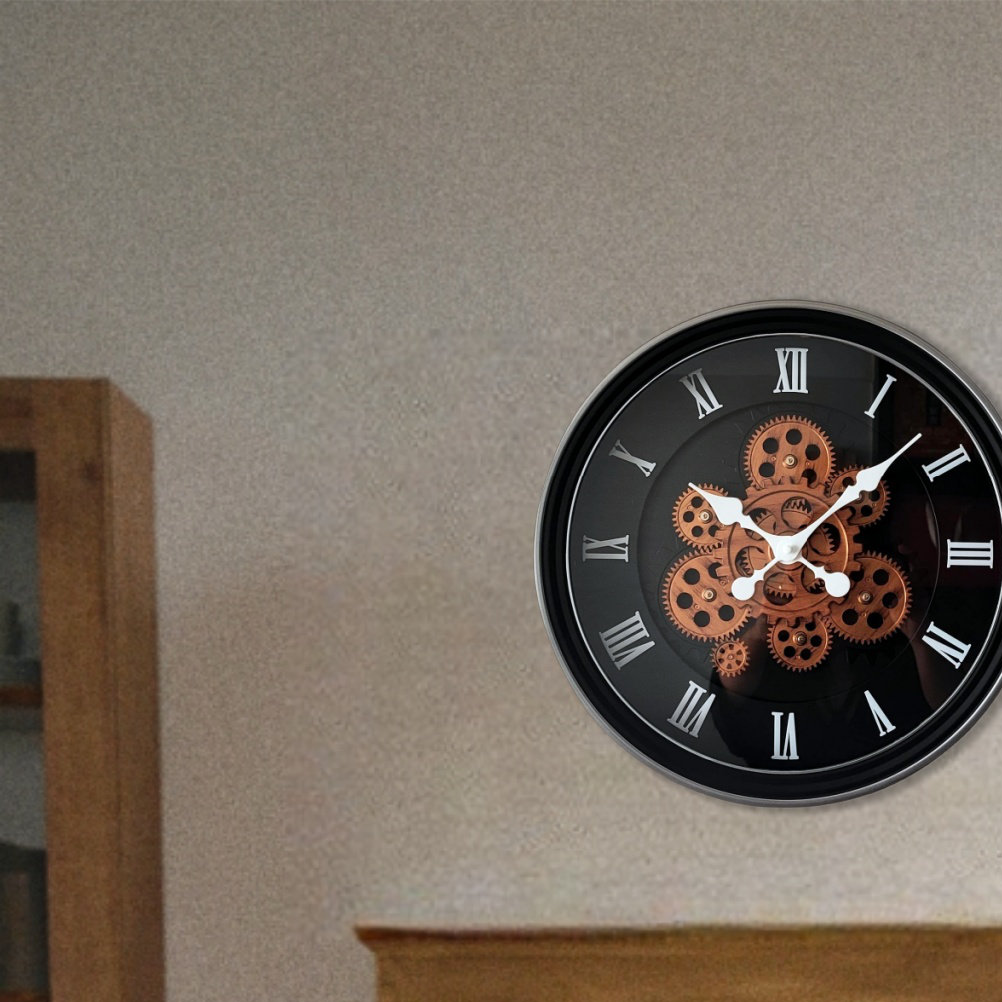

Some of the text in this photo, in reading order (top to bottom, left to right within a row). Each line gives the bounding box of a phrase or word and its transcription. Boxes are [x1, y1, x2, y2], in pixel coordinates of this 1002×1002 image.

[773, 347, 809, 393] XII
[679, 368, 723, 420] XI
[864, 374, 897, 418] I
[609, 439, 657, 476] X
[921, 444, 971, 482] II
[582, 534, 629, 562] IX
[947, 538, 993, 568] III
[599, 611, 655, 670] VIII
[922, 622, 971, 668] IV
[667, 680, 716, 738] VII
[864, 690, 895, 736] V
[771, 711, 799, 760] VI
